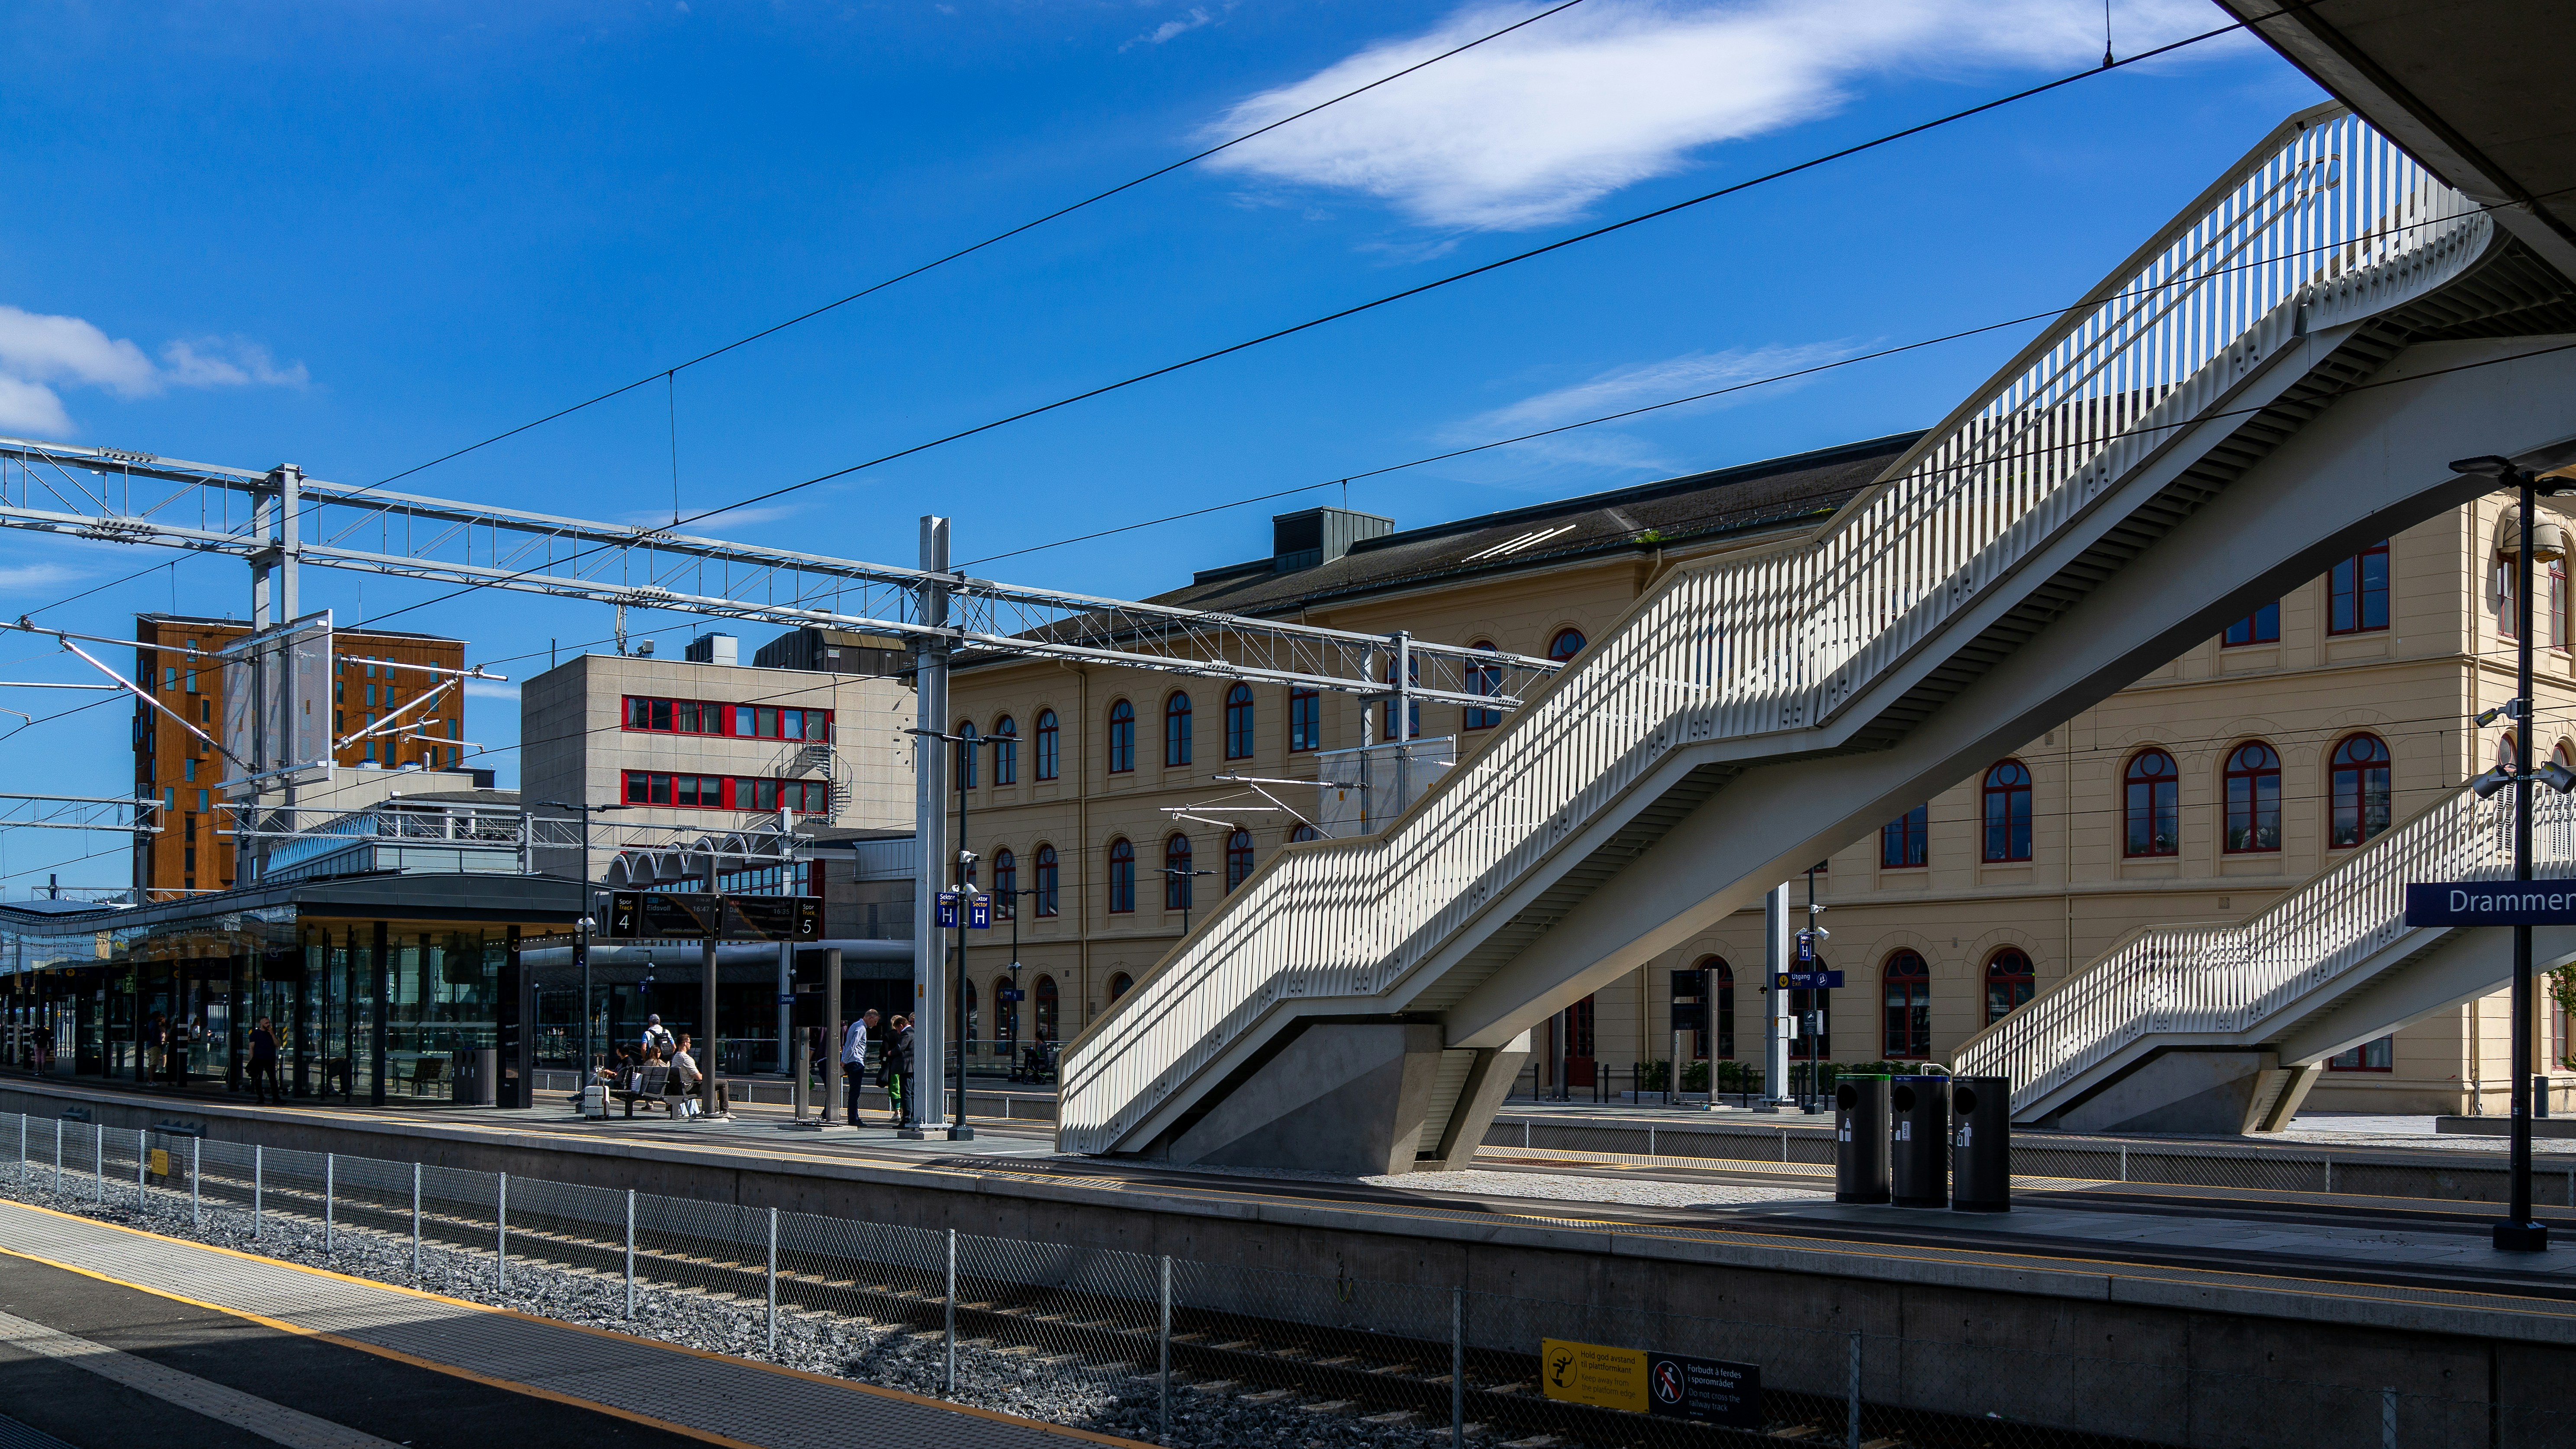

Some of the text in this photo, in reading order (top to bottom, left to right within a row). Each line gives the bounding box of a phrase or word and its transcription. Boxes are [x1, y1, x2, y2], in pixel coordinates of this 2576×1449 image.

[2450, 889, 2576, 912] Drammen
[619, 914, 629, 929] 4
[943, 908, 952, 923] H
[975, 909, 985, 924] H
[802, 920, 811, 934] 5
[1802, 945, 1808, 956] H
[1581, 1350, 1595, 1359] Hold
[1589, 1362, 1632, 1374] plattformkant
[1688, 1364, 1742, 1378] Forbudt å ferdes
[1581, 1374, 1629, 1387] Keep away from
[1691, 1376, 1734, 1388] sporområdet
[1593, 1386, 1619, 1396] platform
[1620, 1389, 1636, 1399] edge
[1688, 1388, 1698, 1397] Do
[1711, 1393, 1728, 1401] cross
[1729, 1394, 1740, 1403] the
[1689, 1400, 1728, 1411] railway track
